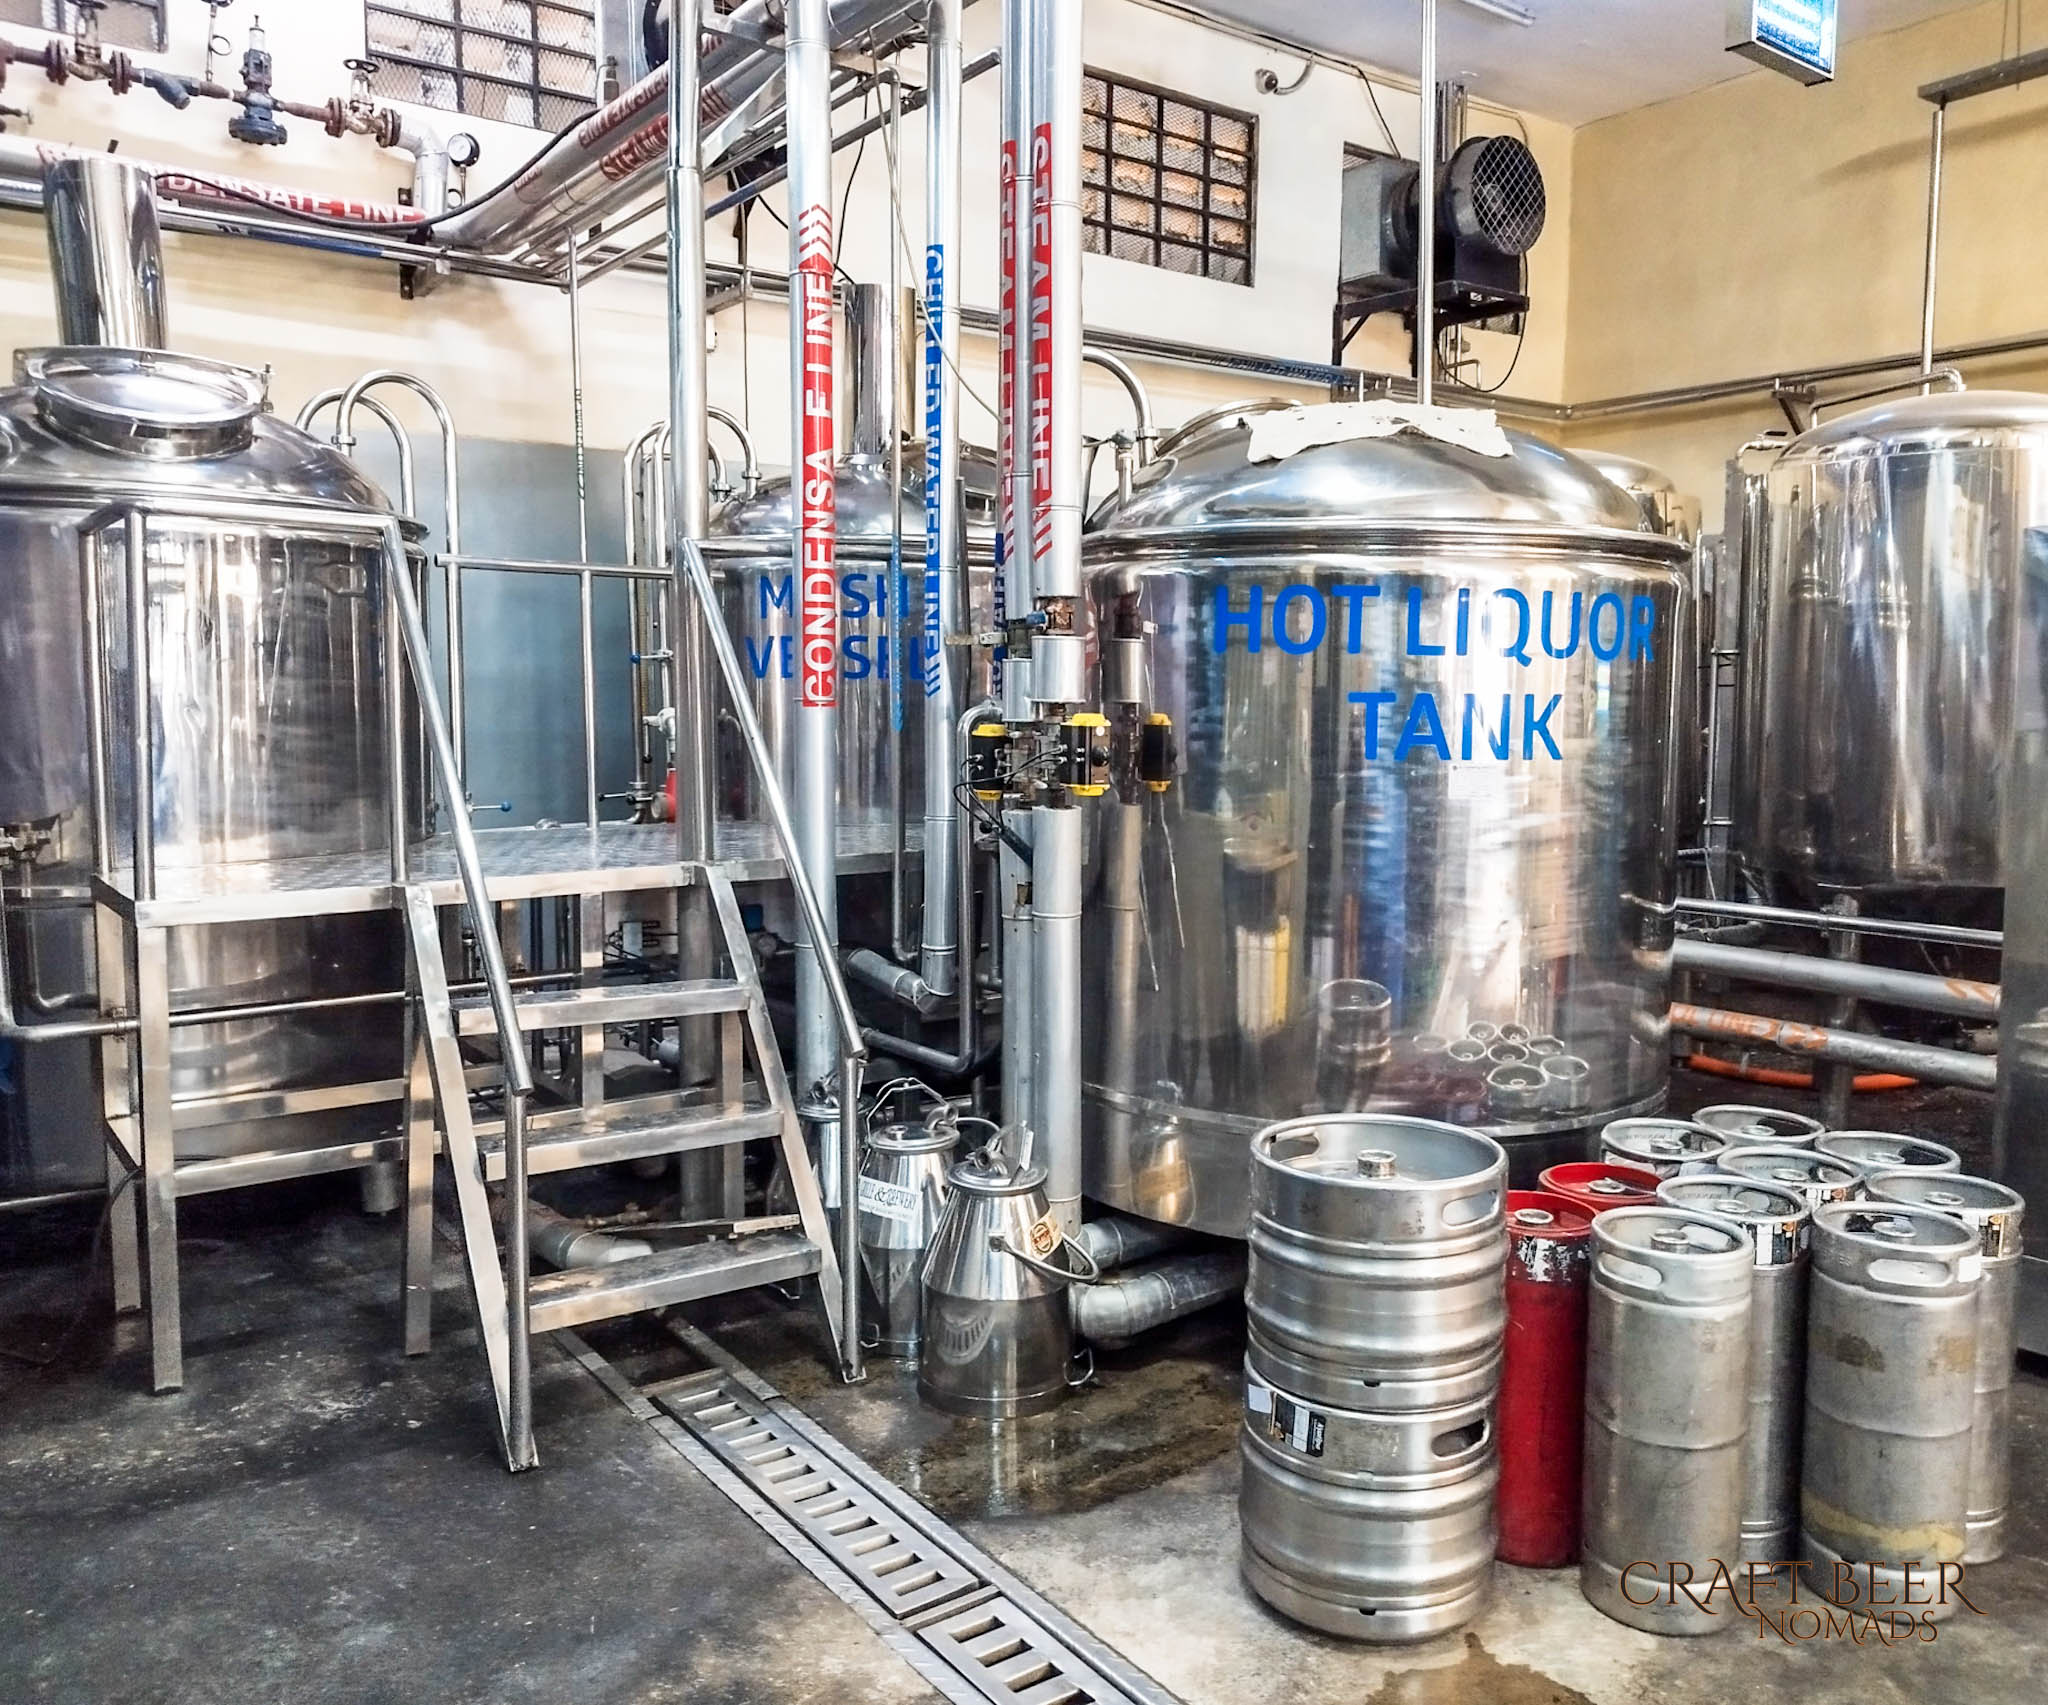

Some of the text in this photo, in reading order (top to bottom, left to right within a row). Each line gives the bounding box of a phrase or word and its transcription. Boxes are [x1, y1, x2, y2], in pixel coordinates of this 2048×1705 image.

[342, 200, 416, 222] LINE
[1032, 135, 1049, 490] STEAM LINE
[926, 424, 941, 556] WATER
[804, 386, 834, 703] CONDENSAE
[759, 573, 909, 619] MSH
[926, 570, 940, 650] LINE
[1213, 584, 1656, 667] HOT LIQUOR
[744, 634, 925, 680] VESEL
[1348, 692, 1564, 761] TANK
